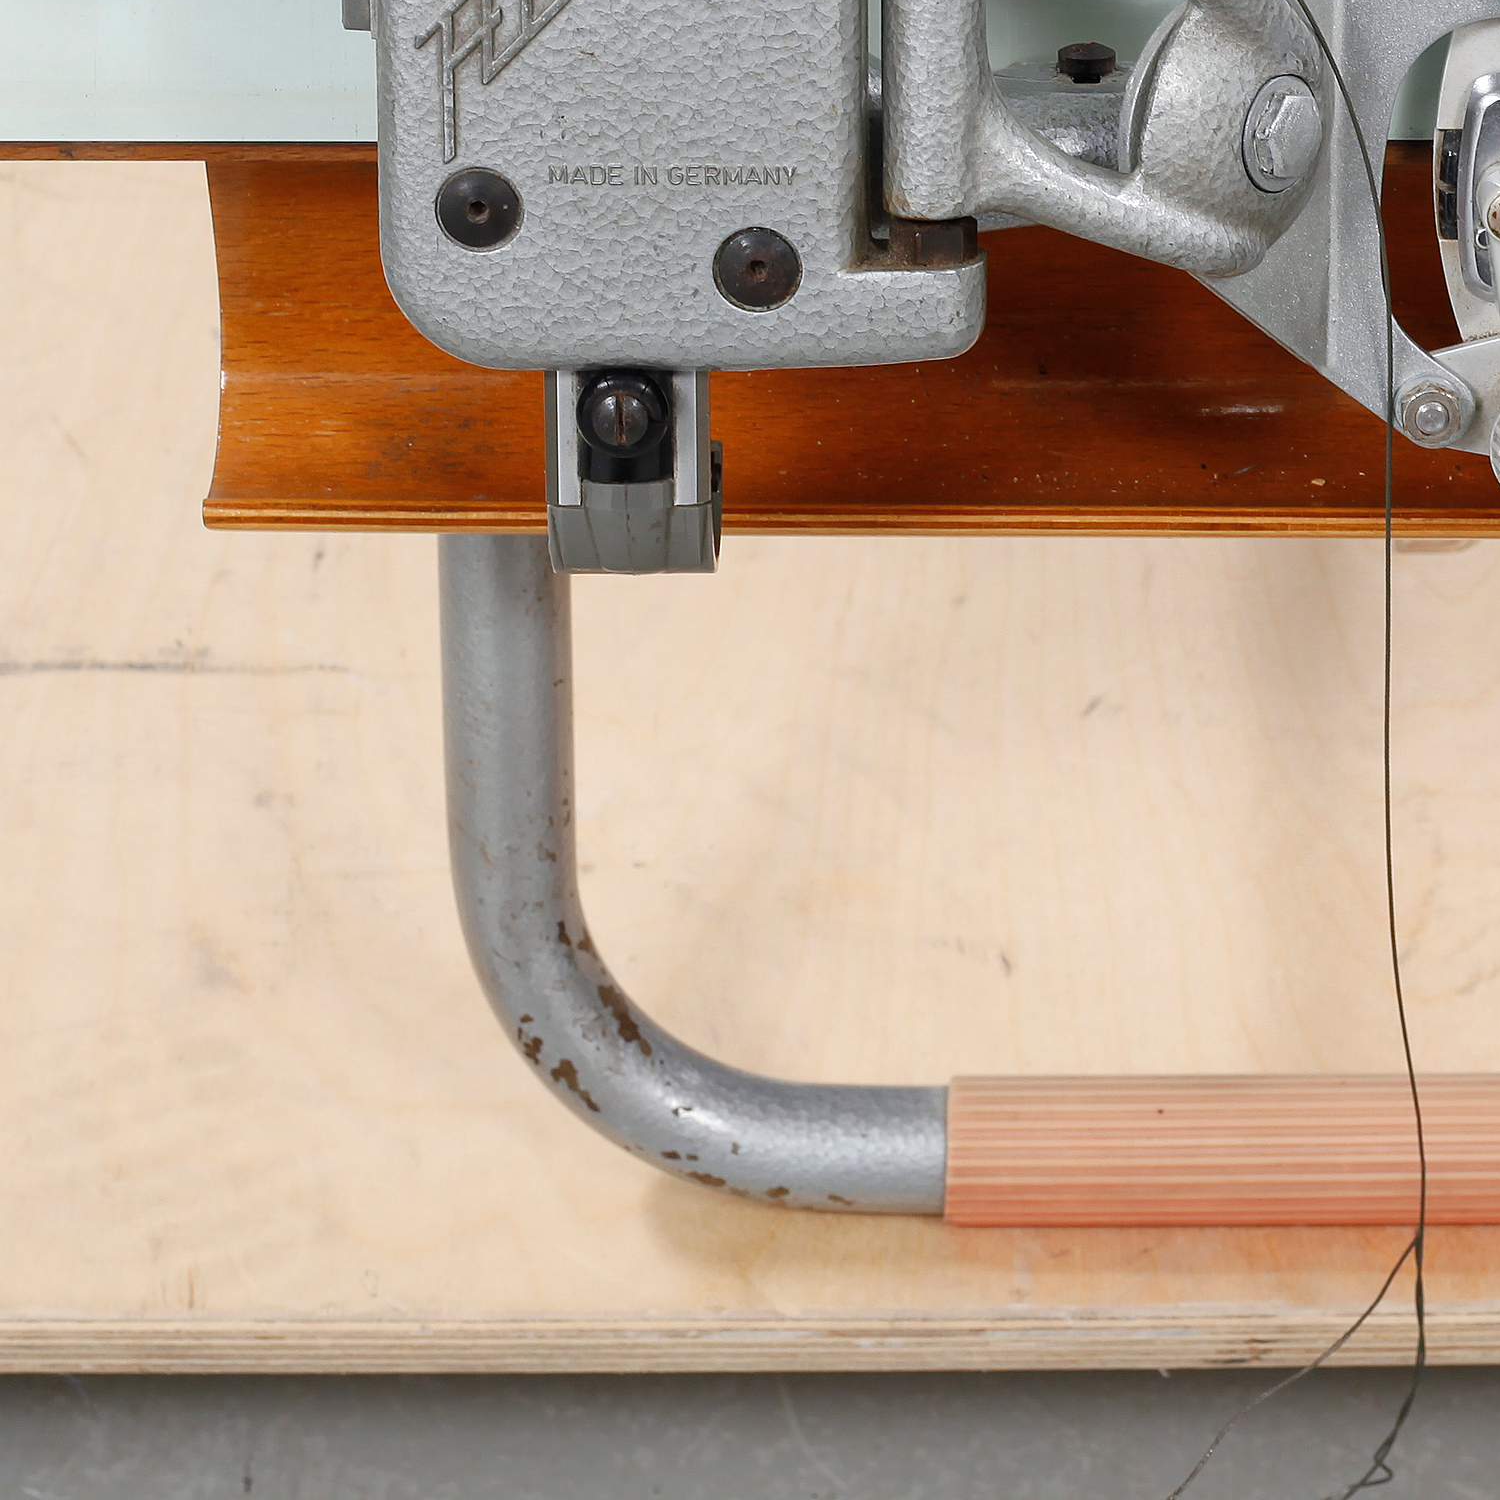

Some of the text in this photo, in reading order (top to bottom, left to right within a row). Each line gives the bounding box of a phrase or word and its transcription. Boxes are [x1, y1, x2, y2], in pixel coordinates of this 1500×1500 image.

[548, 163, 797, 186] MADE IN GERMANY
